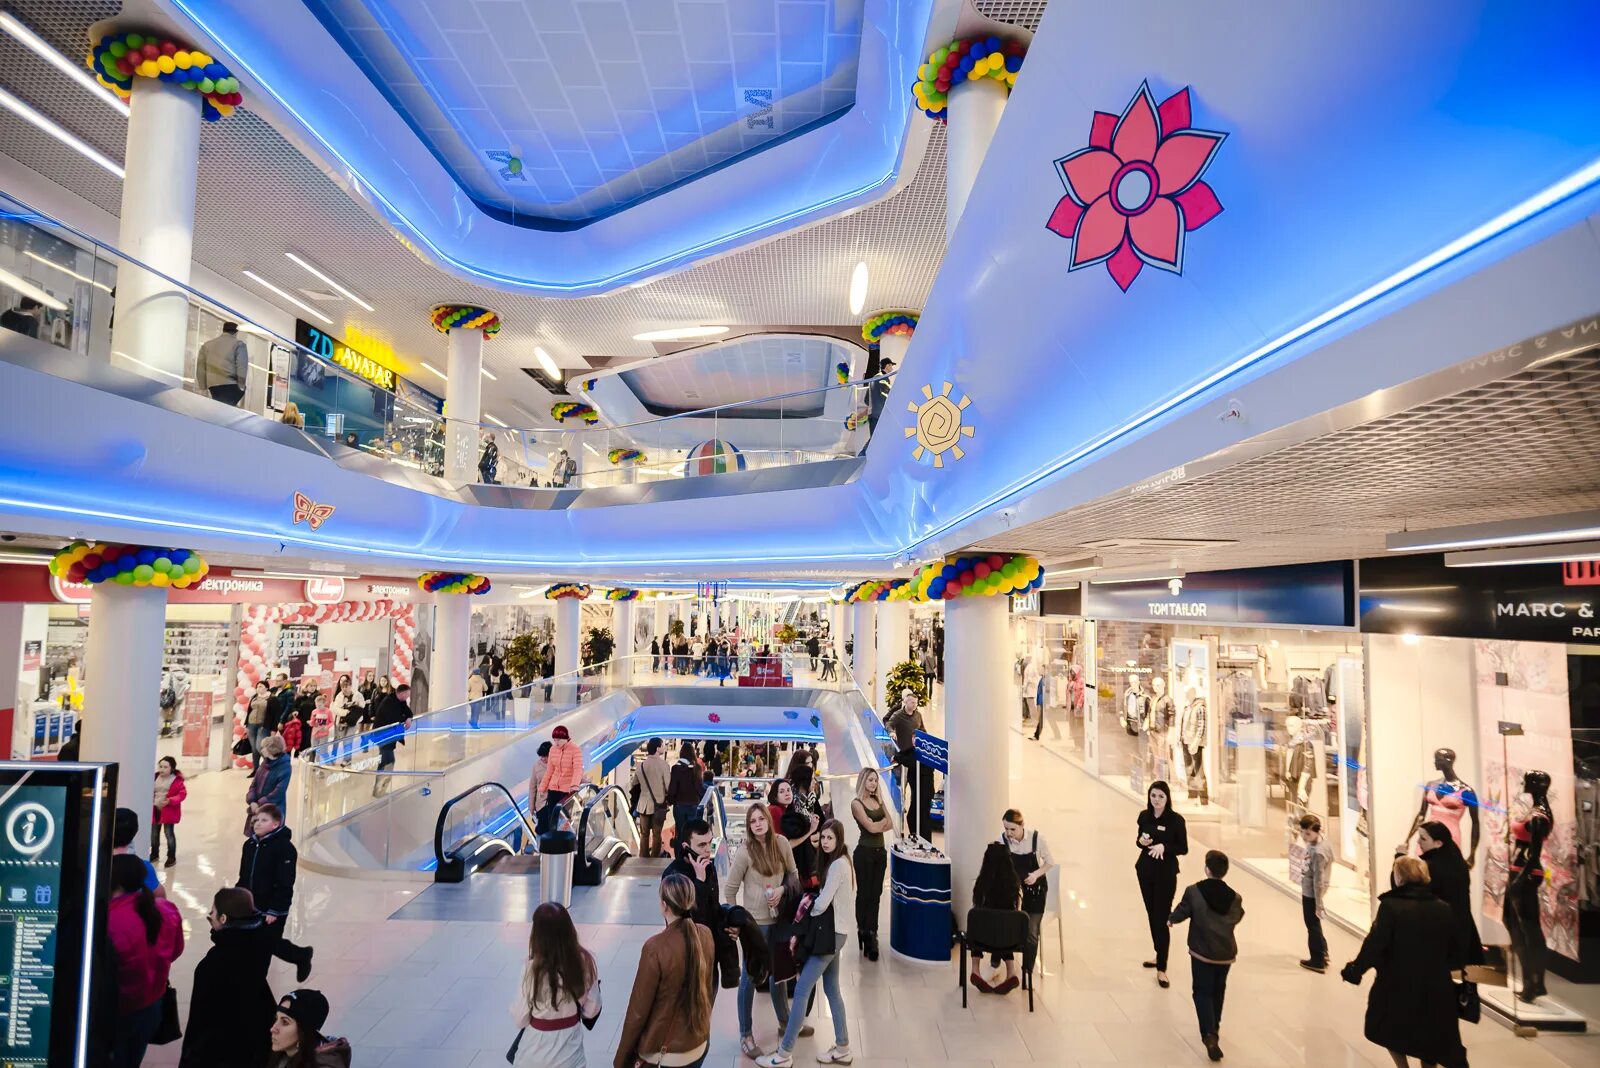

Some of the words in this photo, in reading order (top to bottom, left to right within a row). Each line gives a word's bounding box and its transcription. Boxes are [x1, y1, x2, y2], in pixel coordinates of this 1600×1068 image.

[309, 328, 334, 359] 7D
[341, 346, 394, 389] AVATAR
[197, 578, 264, 595] лектроника
[1148, 602, 1167, 616] TOM
[1167, 602, 1207, 617] TAILOR
[1497, 602, 1566, 618] MARC
[1578, 602, 1594, 618] &
